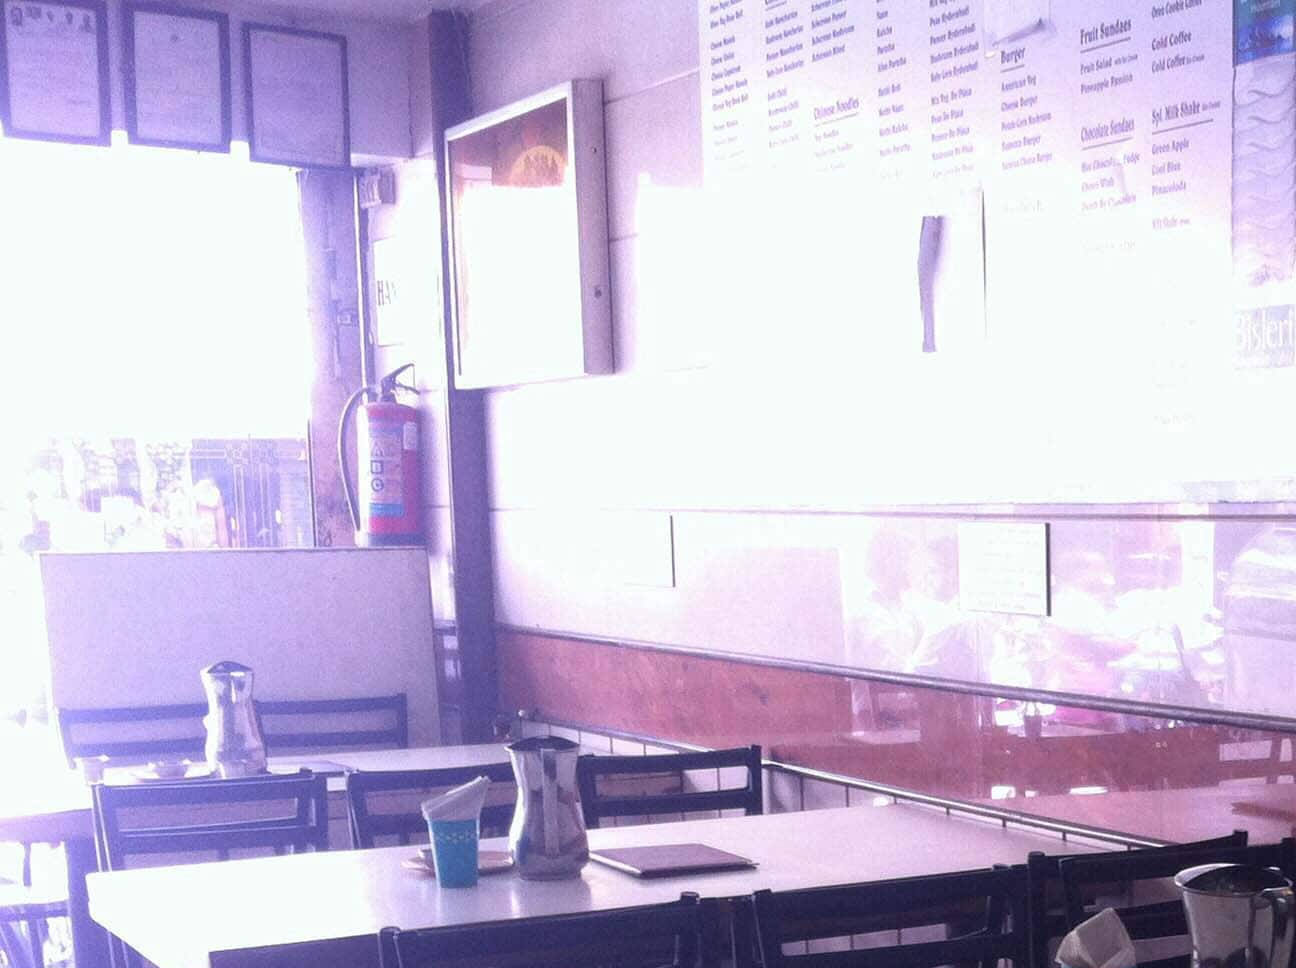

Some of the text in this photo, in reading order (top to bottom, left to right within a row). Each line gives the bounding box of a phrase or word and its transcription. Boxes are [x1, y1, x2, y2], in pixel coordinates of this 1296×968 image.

[1080, 18, 1131, 45] Fruit Sundaes
[1152, 31, 1192, 51] Cold Coffee
[1001, 48, 1025, 64] Burger
[1152, 57, 1165, 73] Cold
[1167, 54, 1185, 70] Coffee
[1152, 138, 1189, 155] Green Apple
